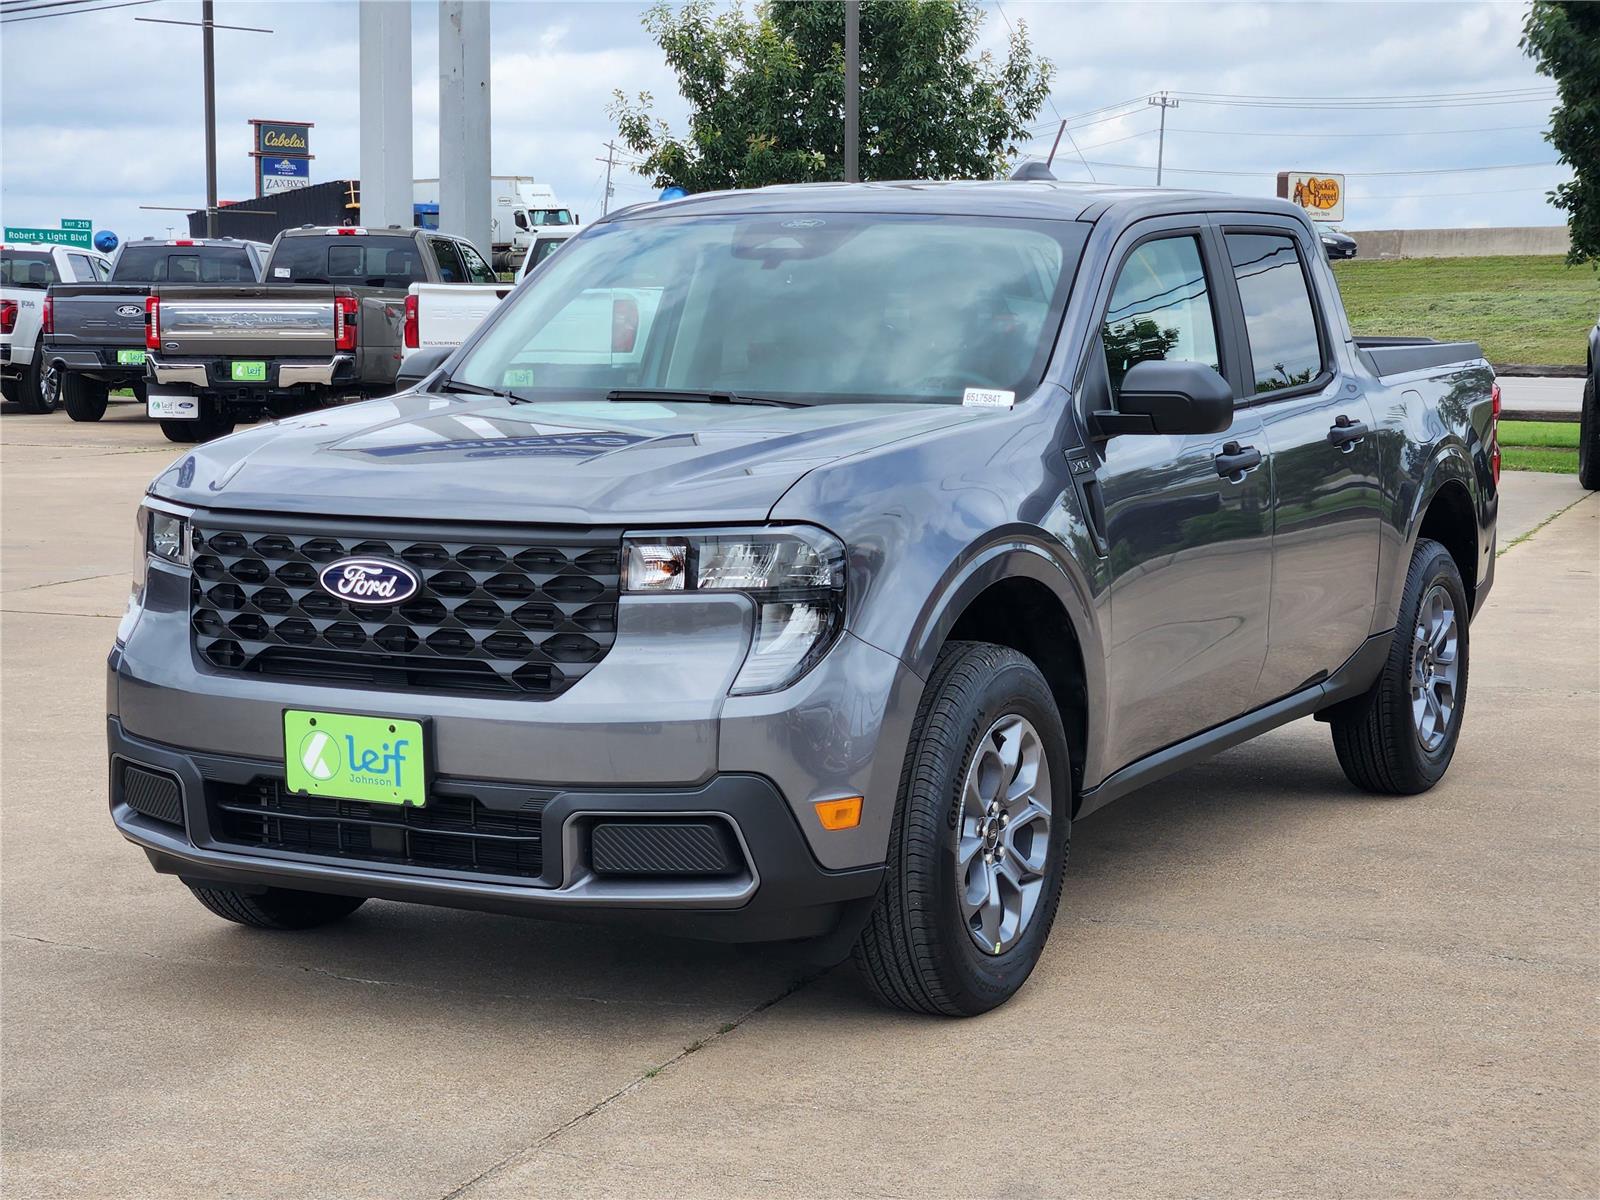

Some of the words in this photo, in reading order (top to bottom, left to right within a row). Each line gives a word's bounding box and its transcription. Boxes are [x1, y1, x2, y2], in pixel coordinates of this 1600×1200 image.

[264, 130, 305, 148] Cabela's
[8, 231, 36, 240] Robert
[39, 232, 44, 240] S
[47, 232, 67, 242] Light
[70, 233, 88, 242] Blvd
[1072, 460, 1090, 472] XLT
[338, 565, 398, 598] Ford
[349, 774, 392, 786] Johnson
